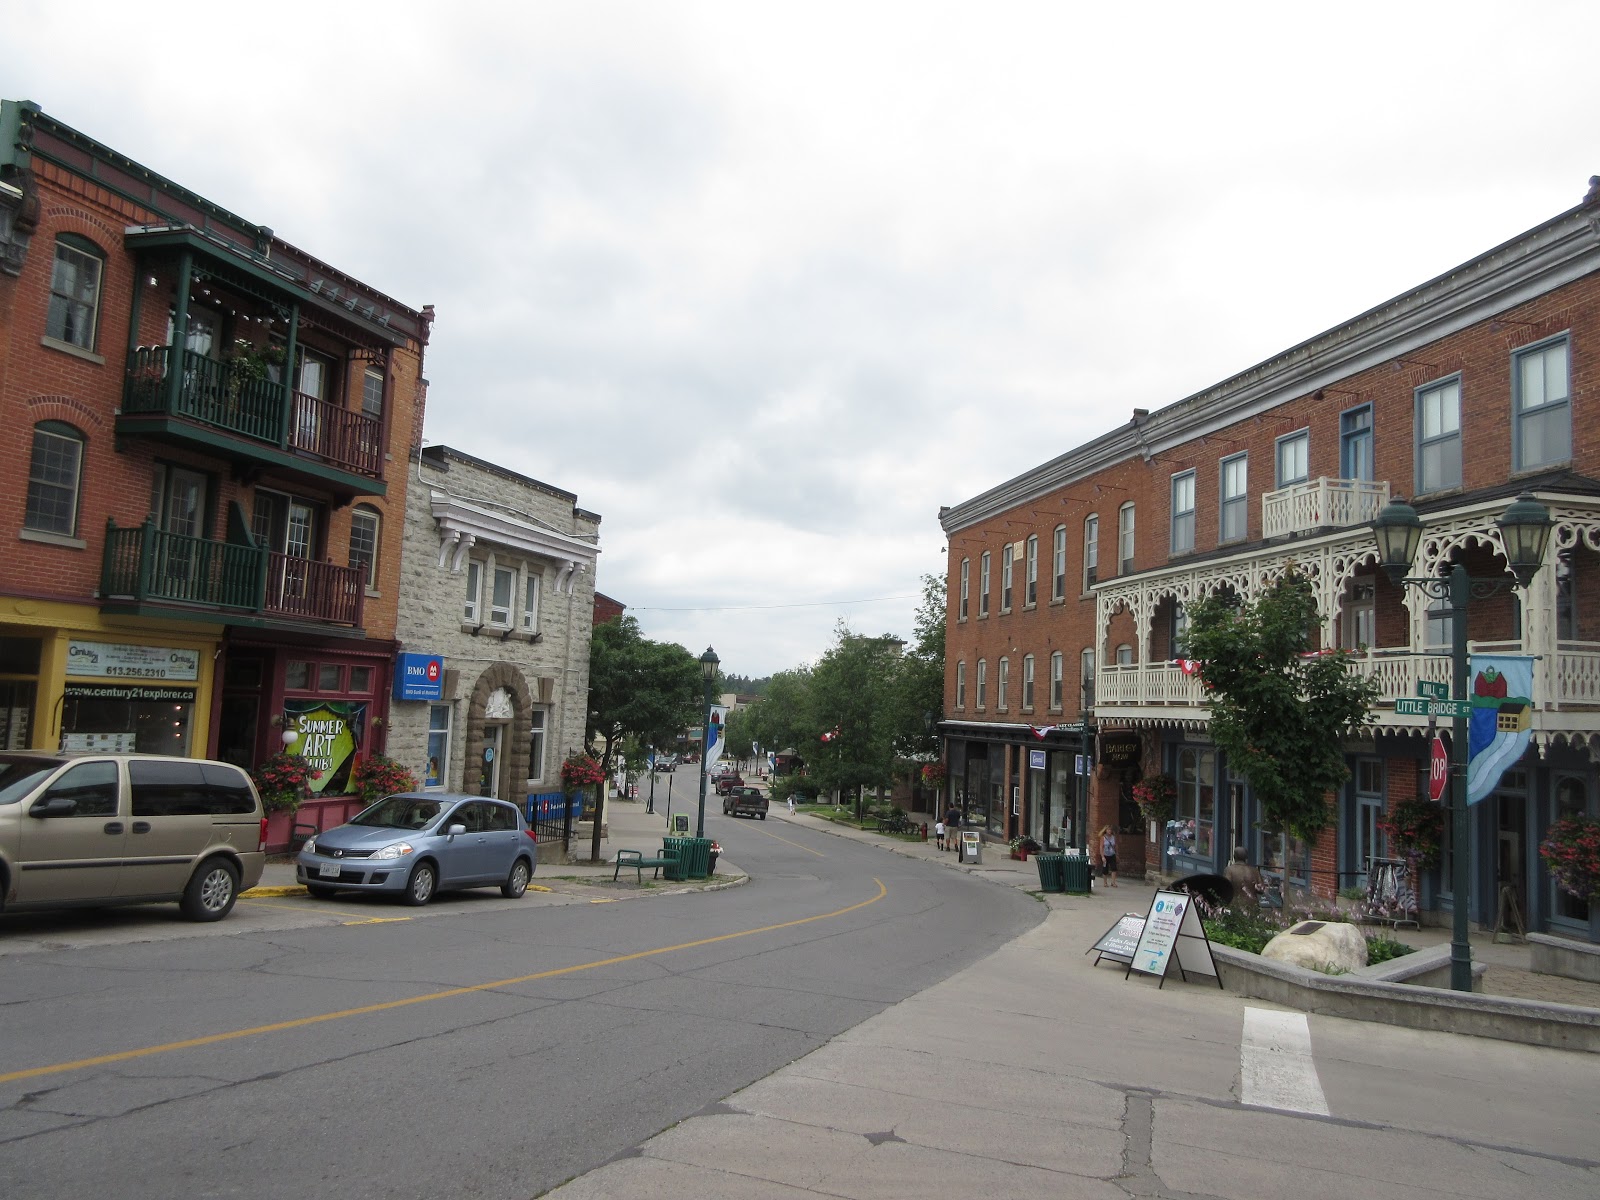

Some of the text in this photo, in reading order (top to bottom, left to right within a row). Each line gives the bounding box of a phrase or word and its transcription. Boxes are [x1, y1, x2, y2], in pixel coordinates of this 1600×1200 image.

[90, 655, 98, 664] 21
[106, 666, 166, 678] 613.256.2310
[407, 666, 425, 676] BMO
[65, 687, 194, 700] www.century21explorer.ca
[1422, 683, 1436, 696] MILL
[1396, 700, 1423, 713] LITTLE
[1427, 702, 1458, 715] BRIDGE
[298, 715, 344, 734] SUMMER
[302, 733, 336, 757] ART
